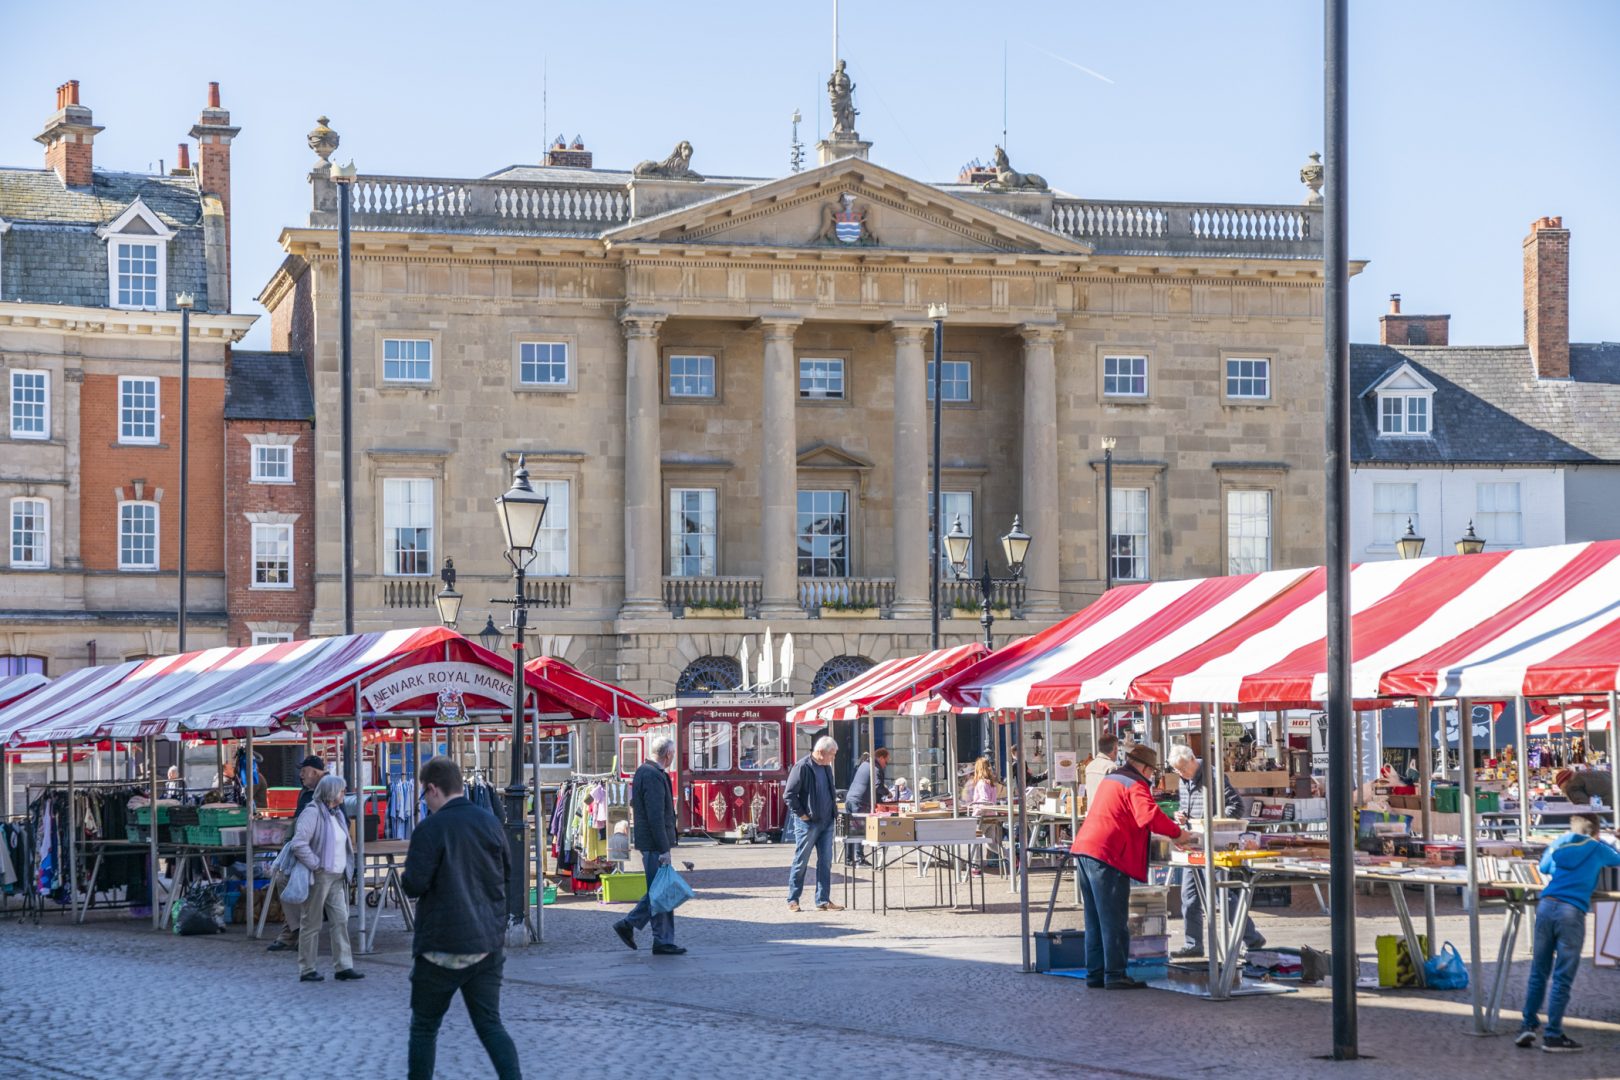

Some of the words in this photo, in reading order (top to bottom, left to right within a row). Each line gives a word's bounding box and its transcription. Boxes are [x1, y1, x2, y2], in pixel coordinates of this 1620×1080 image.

[373, 675, 425, 701] NEWARK
[428, 671, 470, 684] ROYAL
[474, 674, 514, 697] MARKE
[710, 710, 740, 719] Pennie
